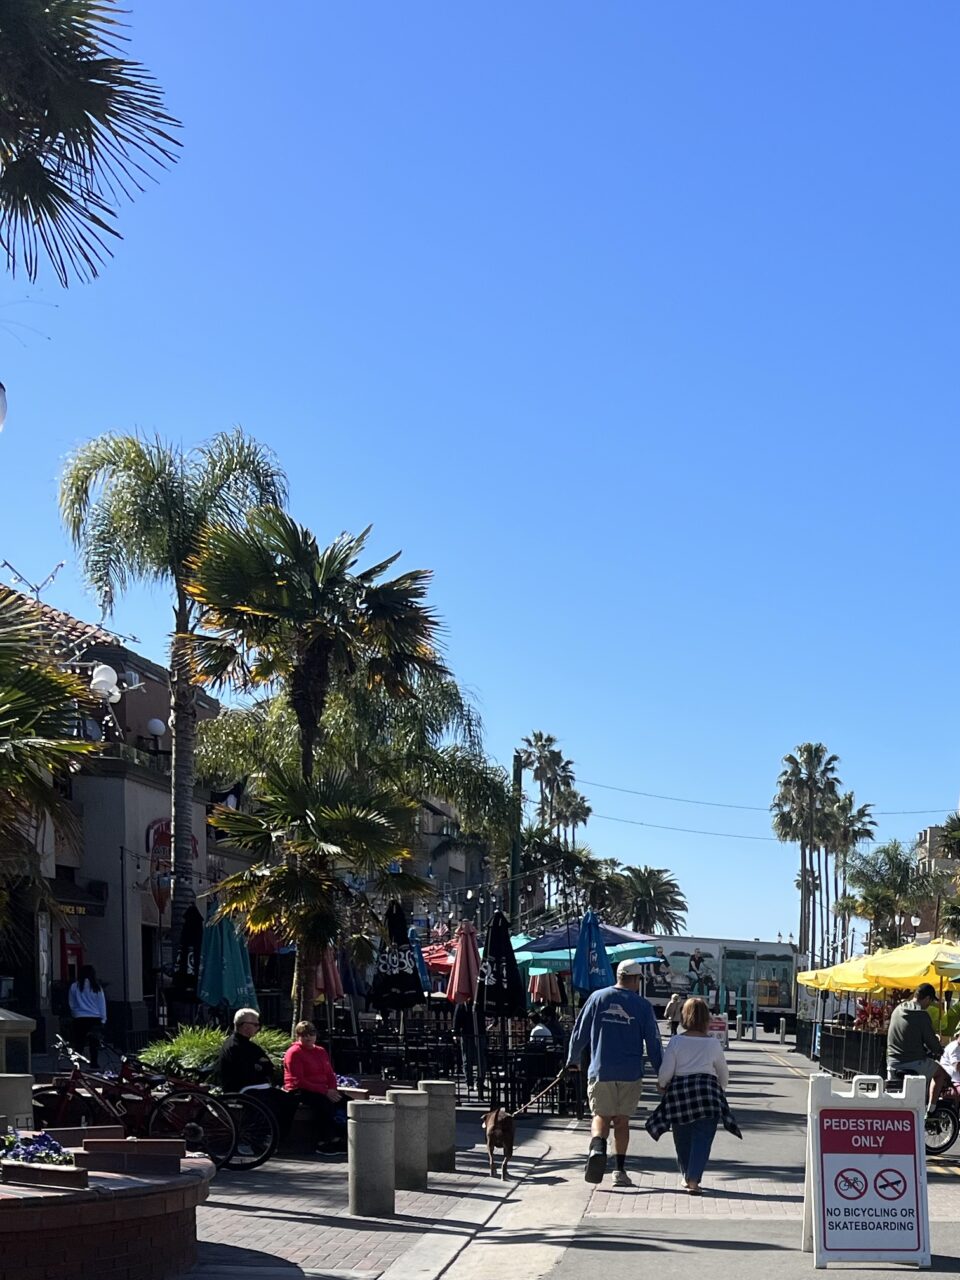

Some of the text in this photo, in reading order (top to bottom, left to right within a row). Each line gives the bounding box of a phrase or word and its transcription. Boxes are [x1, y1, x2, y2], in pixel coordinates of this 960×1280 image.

[823, 1118, 911, 1132] PEDESTRIANS
[851, 1135, 885, 1147] ONLY
[826, 1207, 915, 1218] NO BICYCLING OR
[828, 1221, 914, 1232] SKATEBOARDING
